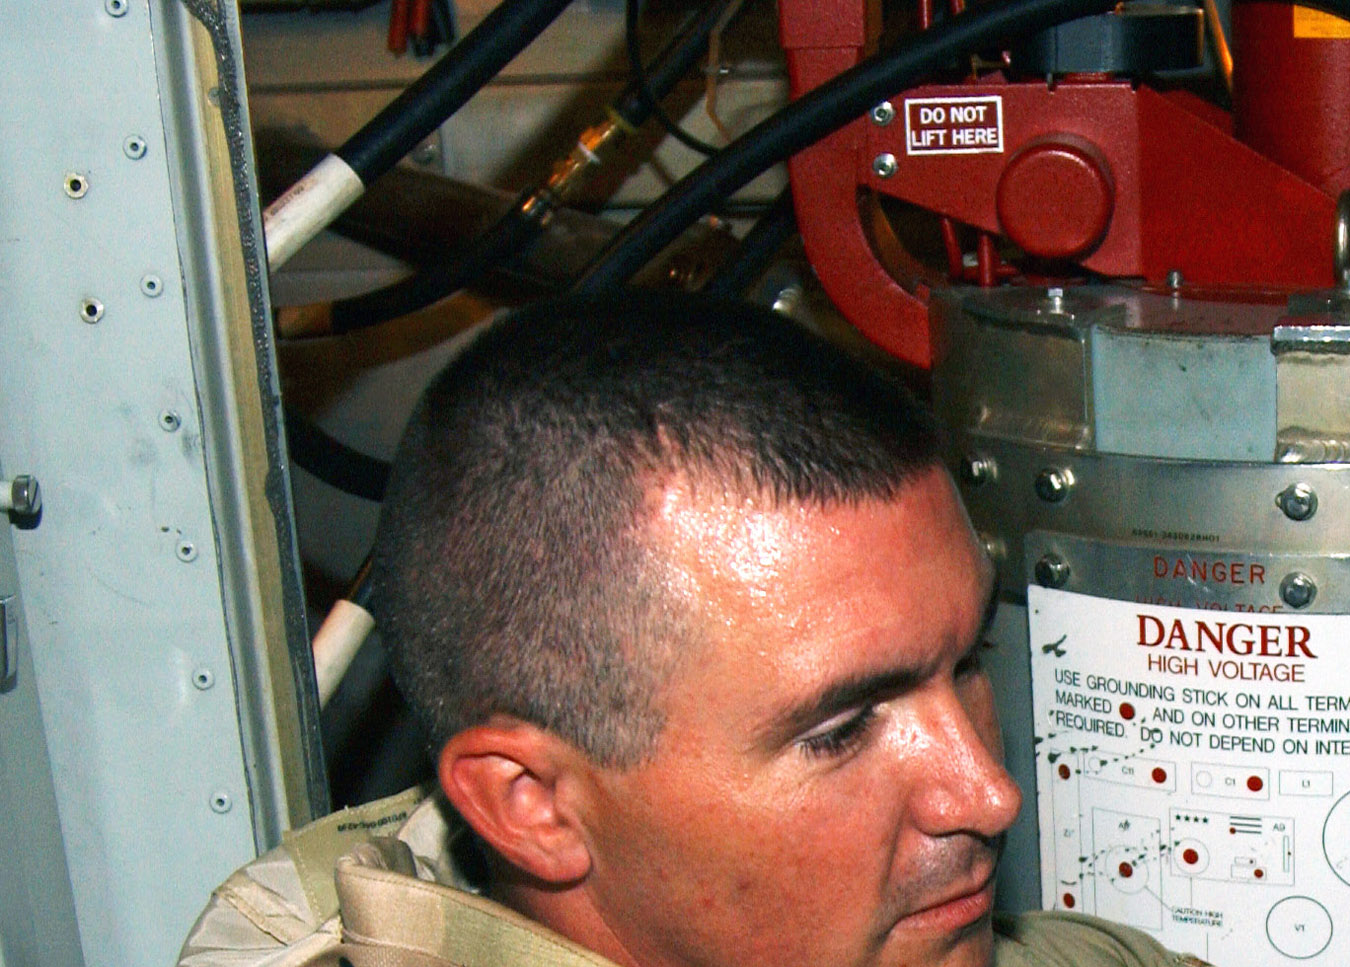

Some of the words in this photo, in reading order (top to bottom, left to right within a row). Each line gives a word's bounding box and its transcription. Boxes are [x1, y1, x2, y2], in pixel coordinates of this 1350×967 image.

[920, 107, 945, 124] DO
[951, 106, 987, 122] NOT
[911, 129, 947, 147] LIFT
[952, 128, 998, 145] HERE
[1153, 554, 1266, 585] DANGER
[1136, 614, 1318, 659] DANGER
[1148, 653, 1199, 677] HIGH
[1208, 658, 1306, 683] VOLTAGE
[1054, 668, 1081, 687] USE
[1086, 674, 1175, 702] GROUNDING
[1182, 688, 1229, 707] STICK
[1235, 692, 1260, 709] ON
[1267, 694, 1299, 711] ALL
[1055, 689, 1112, 714] MARKED
[1153, 706, 1185, 725] AND
[1191, 711, 1216, 727] ON
[1222, 713, 1280, 732] OTHER
[1140, 726, 1163, 744] DO
[1170, 731, 1203, 748] NOT
[1209, 734, 1275, 753] DEPEND
[1282, 738, 1308, 755] ON
[1224, 777, 1236, 786] C1
[1301, 779, 1311, 788] L1
